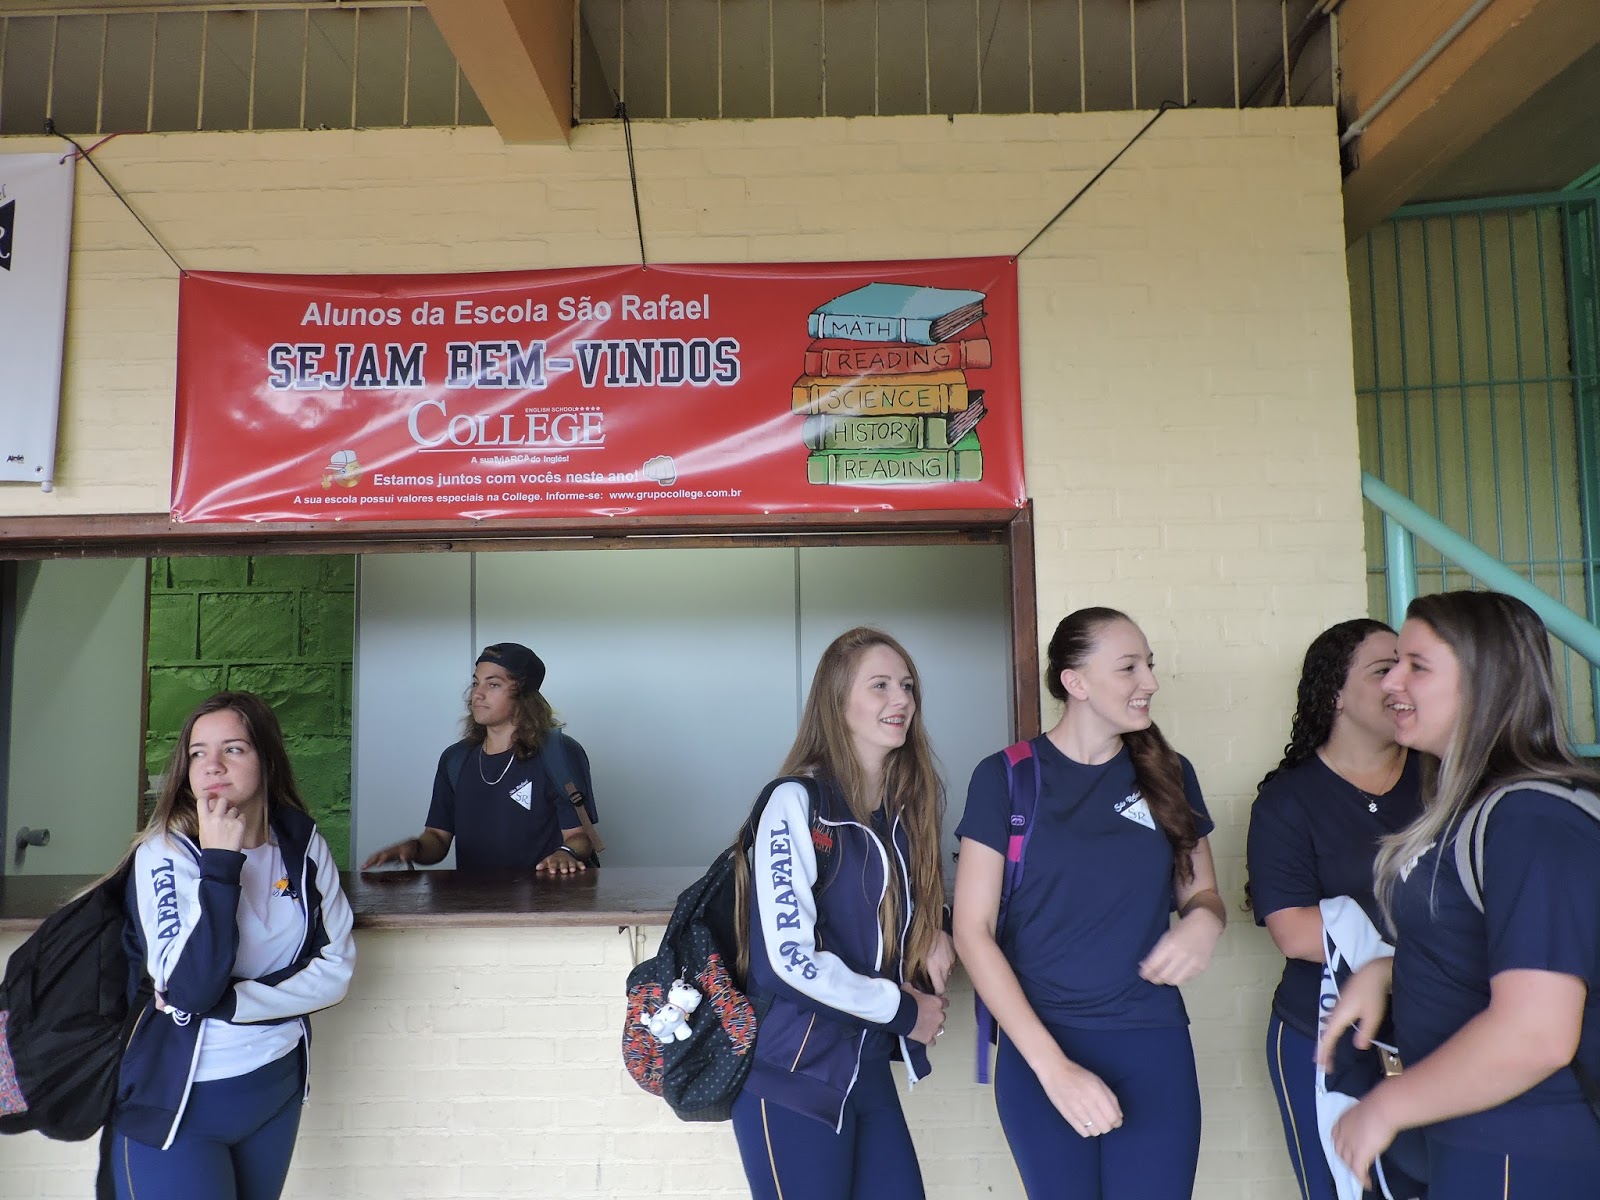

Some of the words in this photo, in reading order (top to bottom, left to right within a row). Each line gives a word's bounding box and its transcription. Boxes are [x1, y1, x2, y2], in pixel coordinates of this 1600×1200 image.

[301, 302, 401, 326] Alunos
[412, 301, 445, 326] da
[455, 299, 548, 325] Escola
[557, 296, 612, 321] São
[621, 294, 710, 320] Rafael
[831, 320, 891, 337] MATH
[268, 342, 426, 391] SEJAM
[445, 337, 741, 390] BEM-VINDOS
[838, 348, 951, 370] READING
[827, 388, 933, 410] SCIENCE
[407, 400, 606, 447] COLLEGE
[834, 422, 917, 442] HISTORY
[471, 456, 478, 464] A
[844, 457, 941, 479] READING
[373, 473, 434, 486] Estamos
[437, 473, 482, 487] juntos
[486, 474, 516, 484] com
[520, 471, 562, 483] vocês
[566, 471, 604, 483] neste
[608, 470, 639, 482] ano!
[293, 495, 302, 504] A
[303, 496, 322, 504] sua
[324, 495, 358, 504] escola
[360, 494, 394, 505] possui
[397, 494, 434, 503] valores
[436, 493, 484, 504] especiais
[486, 494, 499, 502] na
[502, 491, 543, 503] College.
[546, 491, 603, 501] Informe-se:
[609, 488, 742, 501] www.grupocollege.com.br
[770, 819, 801, 932] RAFAEL
[151, 858, 182, 939] AFAEL
